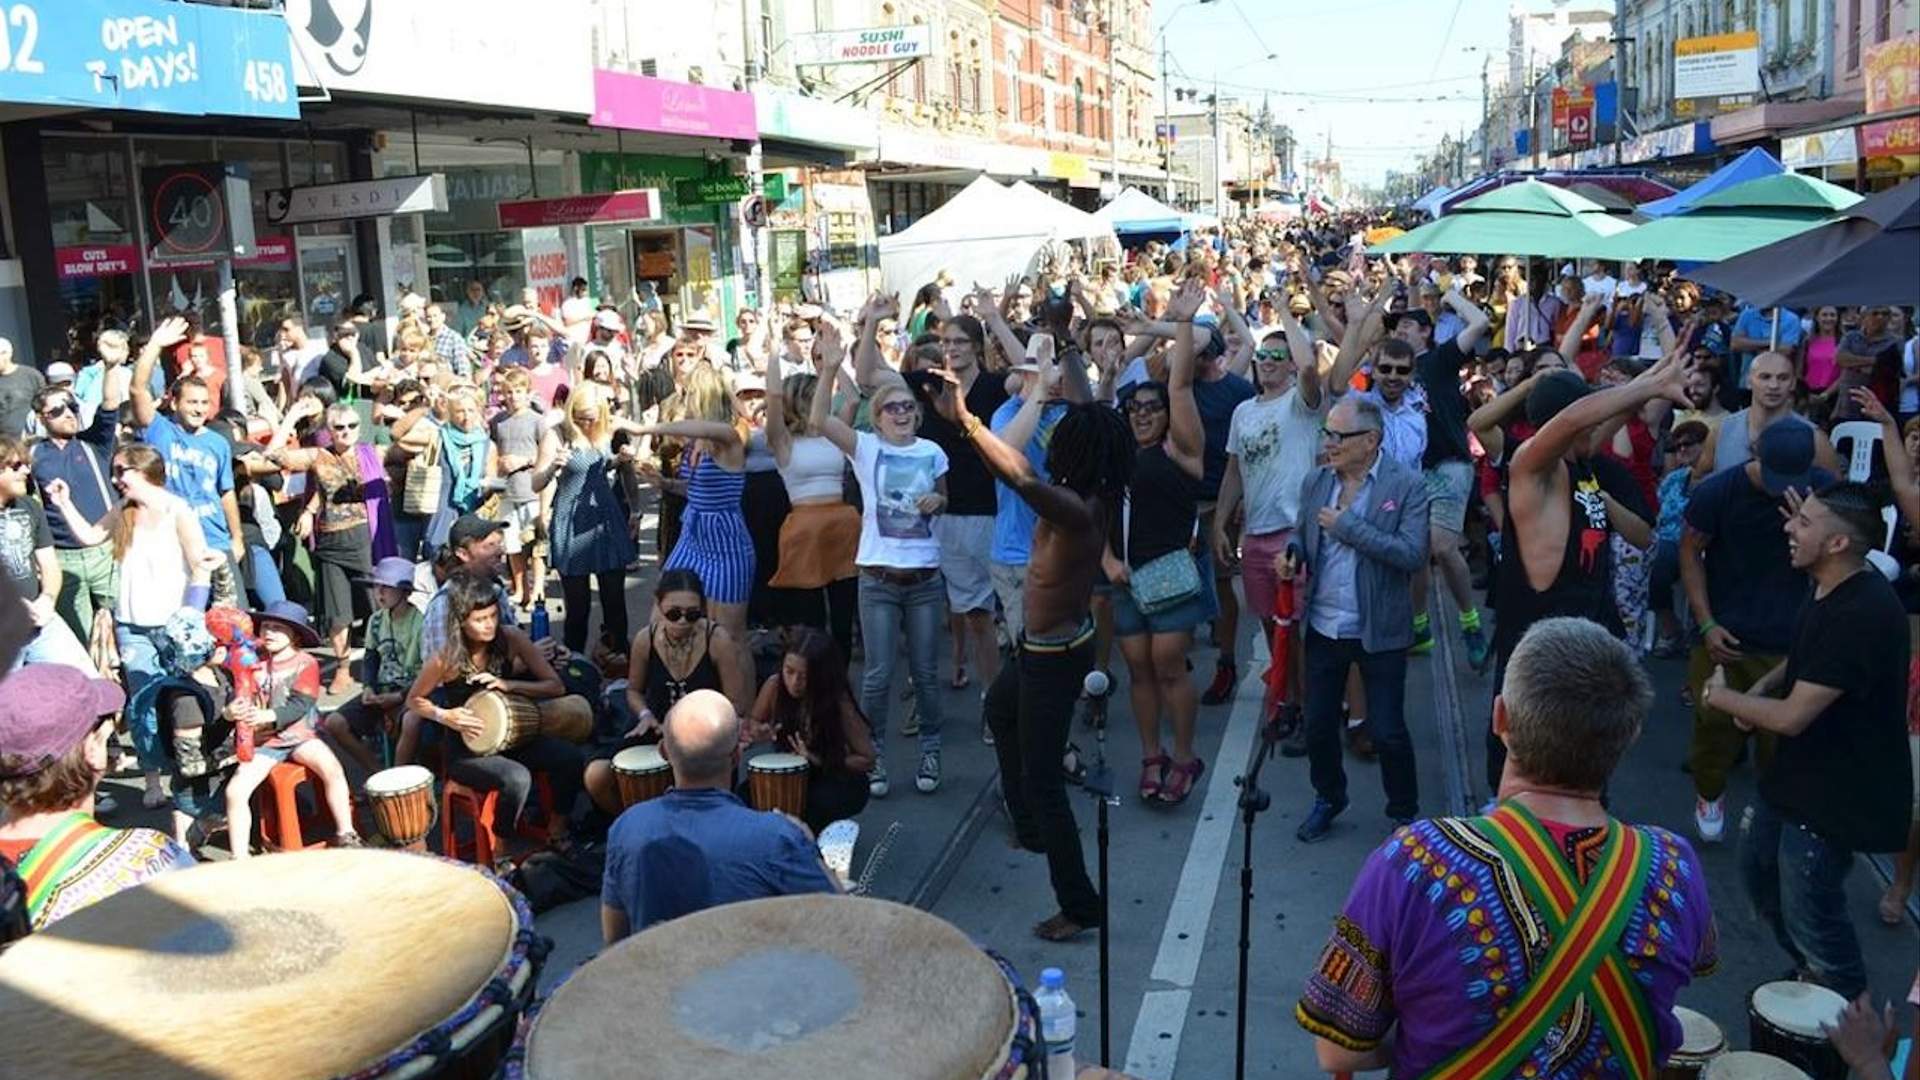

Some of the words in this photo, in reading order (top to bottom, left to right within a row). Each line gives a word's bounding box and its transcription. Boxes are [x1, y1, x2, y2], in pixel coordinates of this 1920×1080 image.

[102, 15, 178, 50] OPEN
[859, 30, 904, 44] SUSHI
[842, 43, 888, 58] NOODLE
[893, 41, 918, 54] GUY
[120, 42, 198, 90] DAYS!
[244, 60, 288, 103] 458
[168, 195, 213, 230] 40
[82, 249, 108, 261] CUTS
[64, 262, 94, 275] BLOW
